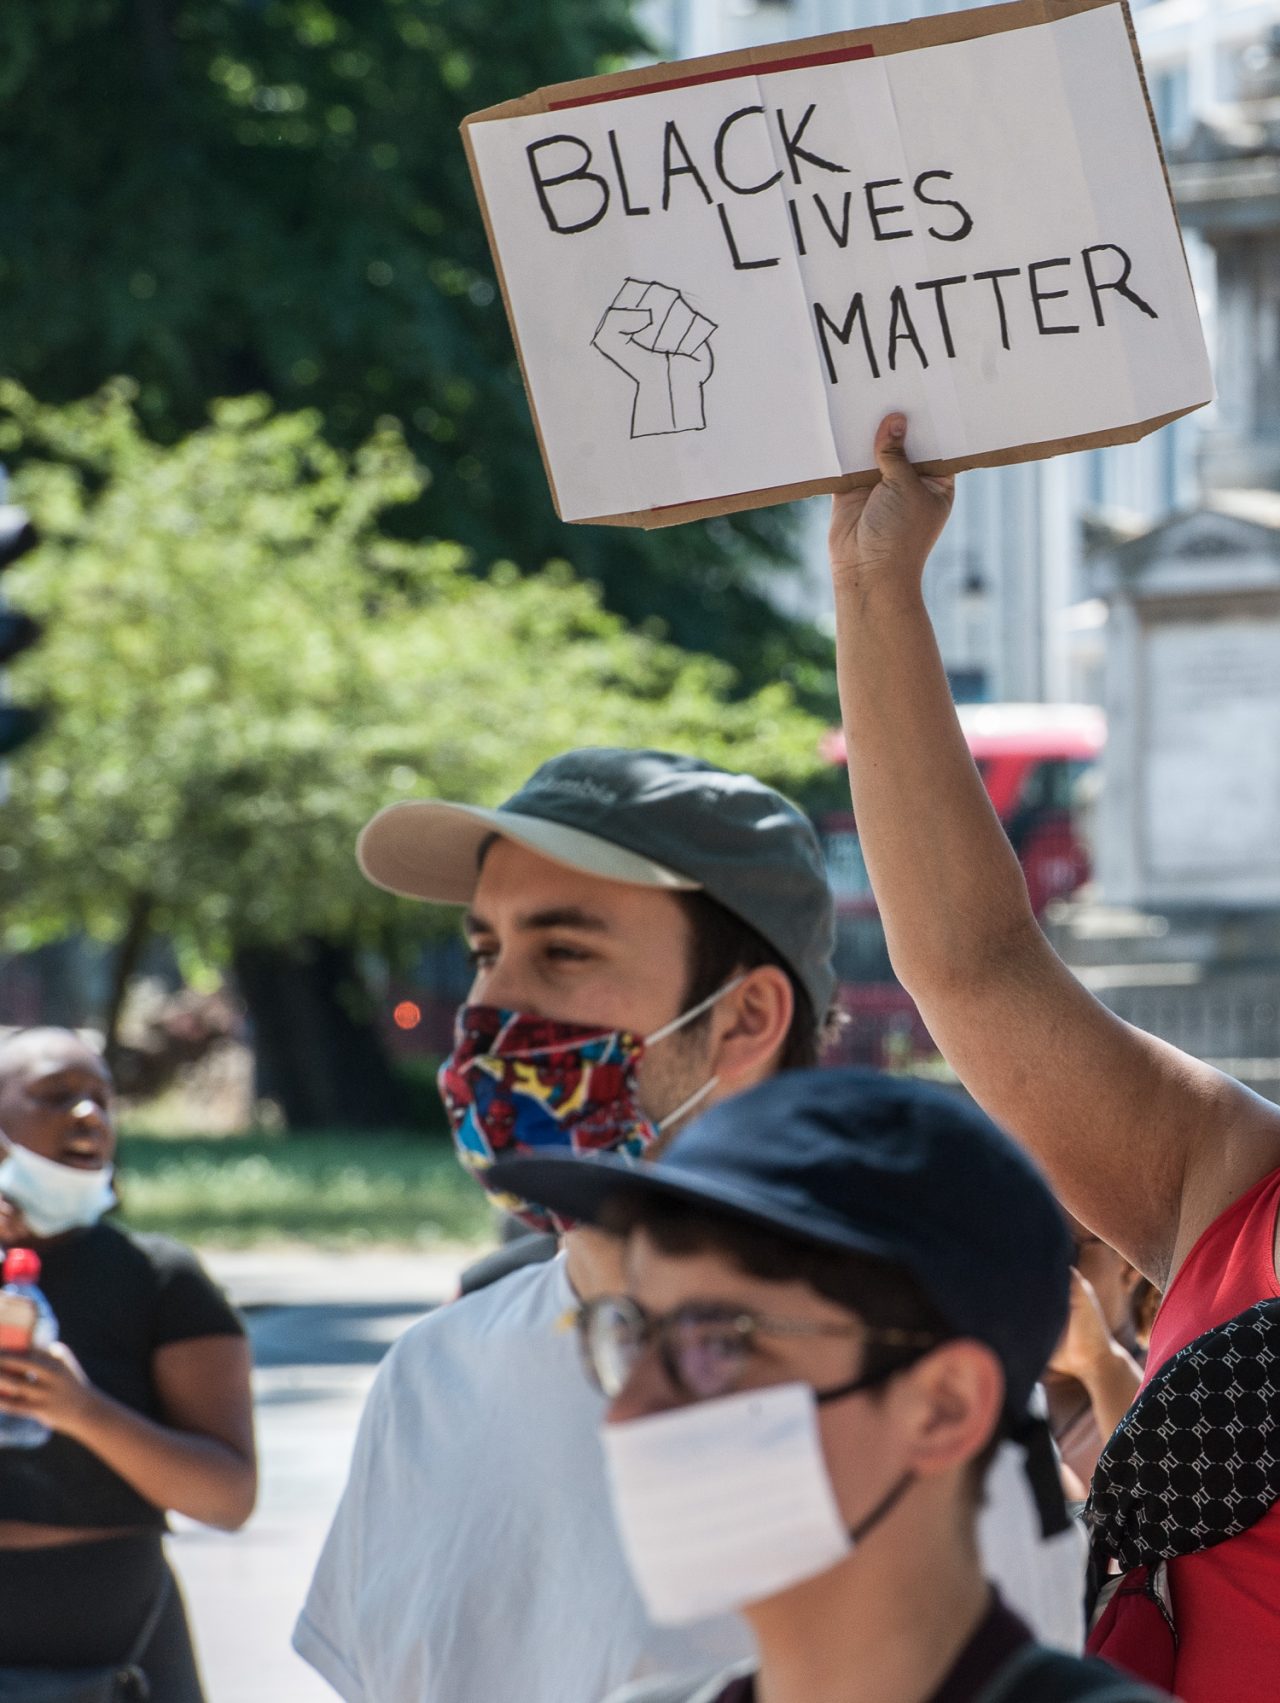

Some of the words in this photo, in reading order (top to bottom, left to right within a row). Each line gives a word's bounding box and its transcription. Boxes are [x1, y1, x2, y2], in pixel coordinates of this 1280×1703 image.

[525, 104, 851, 235] BLACK
[717, 169, 974, 271] LIVES
[813, 243, 1158, 385] MATTER
[1252, 1316, 1272, 1335] PLT
[1188, 1349, 1209, 1370] PLT
[1222, 1347, 1242, 1368] PLT
[1256, 1346, 1275, 1367] PLT
[1156, 1384, 1177, 1406] PLT
[1189, 1382, 1210, 1405] PLT
[1224, 1379, 1244, 1402] PLT
[1256, 1380, 1277, 1401] PLT
[1123, 1418, 1144, 1441] PLT
[1156, 1418, 1178, 1440] PLT
[1191, 1416, 1212, 1438] PLT
[1224, 1415, 1245, 1438] PLT
[1258, 1414, 1277, 1437] PLT
[1098, 1451, 1115, 1472] PLT
[1127, 1451, 1145, 1470] PLT
[1158, 1451, 1179, 1473] PLT
[1191, 1452, 1212, 1475] PLT
[1224, 1451, 1244, 1474] PLT
[1255, 1450, 1276, 1473] PLT
[1106, 1482, 1124, 1498] PLT
[1130, 1482, 1150, 1499] PLT
[1159, 1485, 1179, 1504] PLT
[1191, 1486, 1211, 1509] PLT
[1223, 1487, 1244, 1510] PLT
[1256, 1485, 1278, 1505] PLT
[1159, 1514, 1180, 1534] PLT
[1190, 1520, 1210, 1537] PLT
[1224, 1519, 1244, 1536] PLT
[1159, 1545, 1179, 1559] PLT
